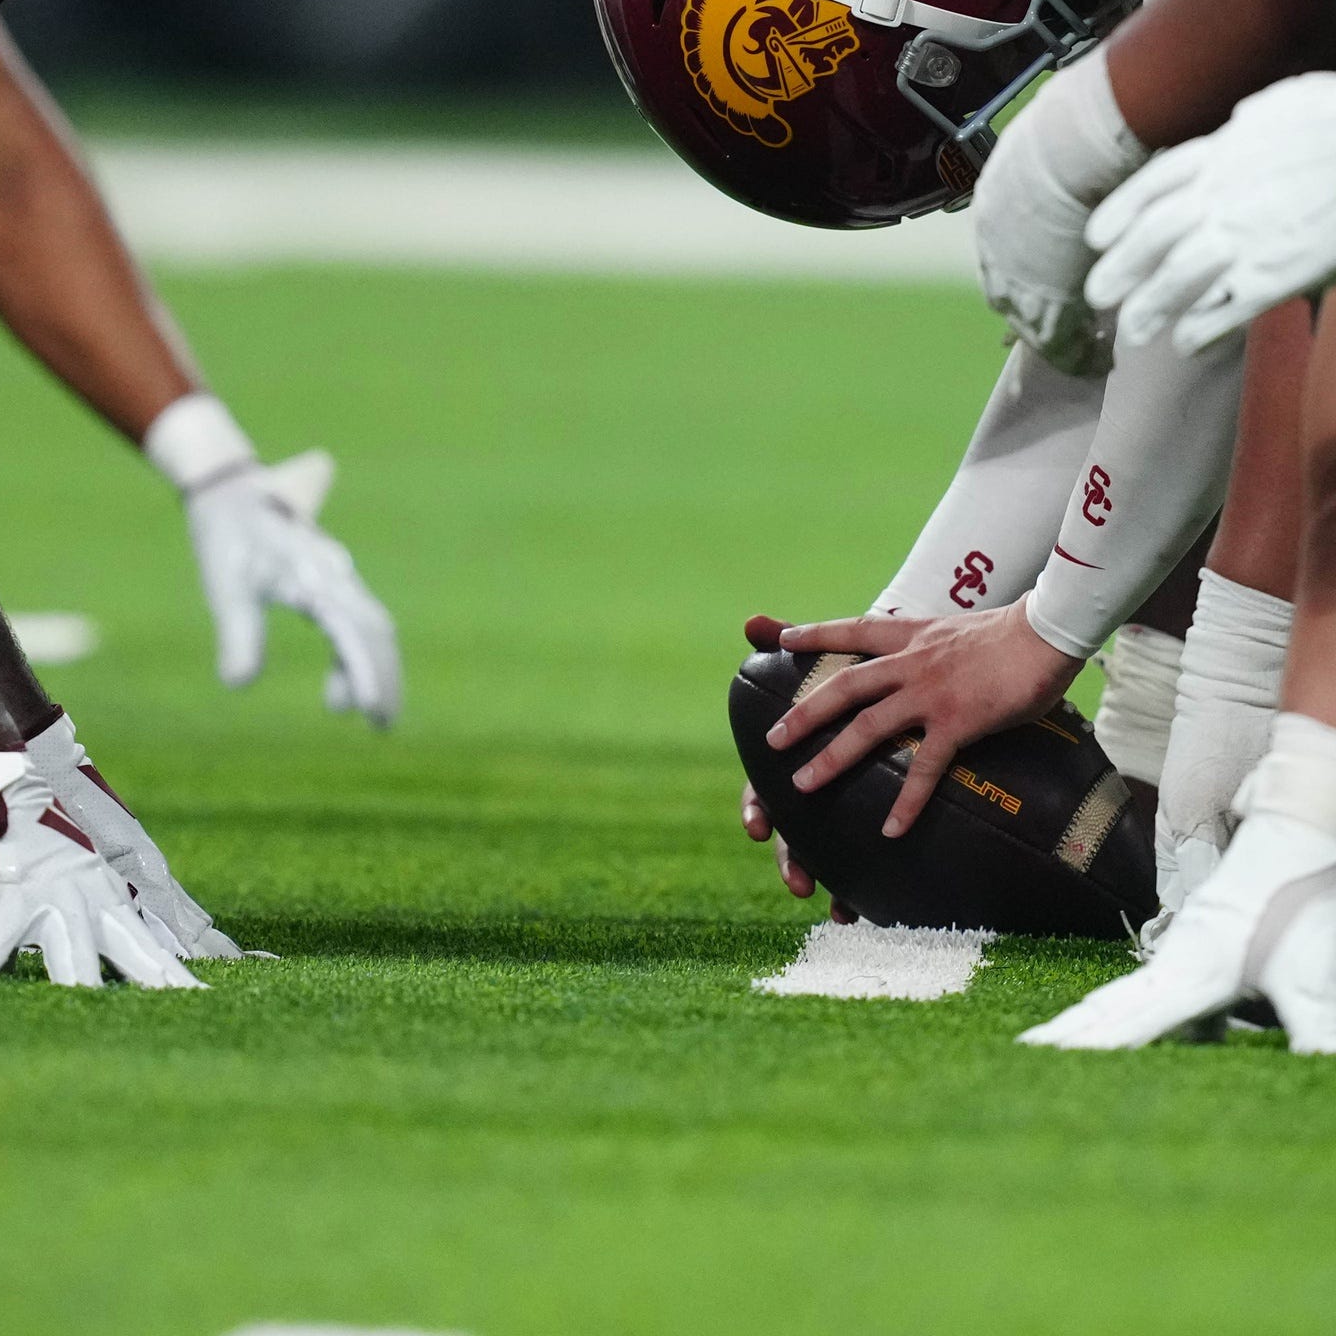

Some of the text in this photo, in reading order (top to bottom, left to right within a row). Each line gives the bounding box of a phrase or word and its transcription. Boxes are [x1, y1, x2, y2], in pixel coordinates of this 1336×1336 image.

[1082, 464, 1112, 526] SC
[949, 550, 994, 609] SC
[950, 766, 1023, 815] ELITE
